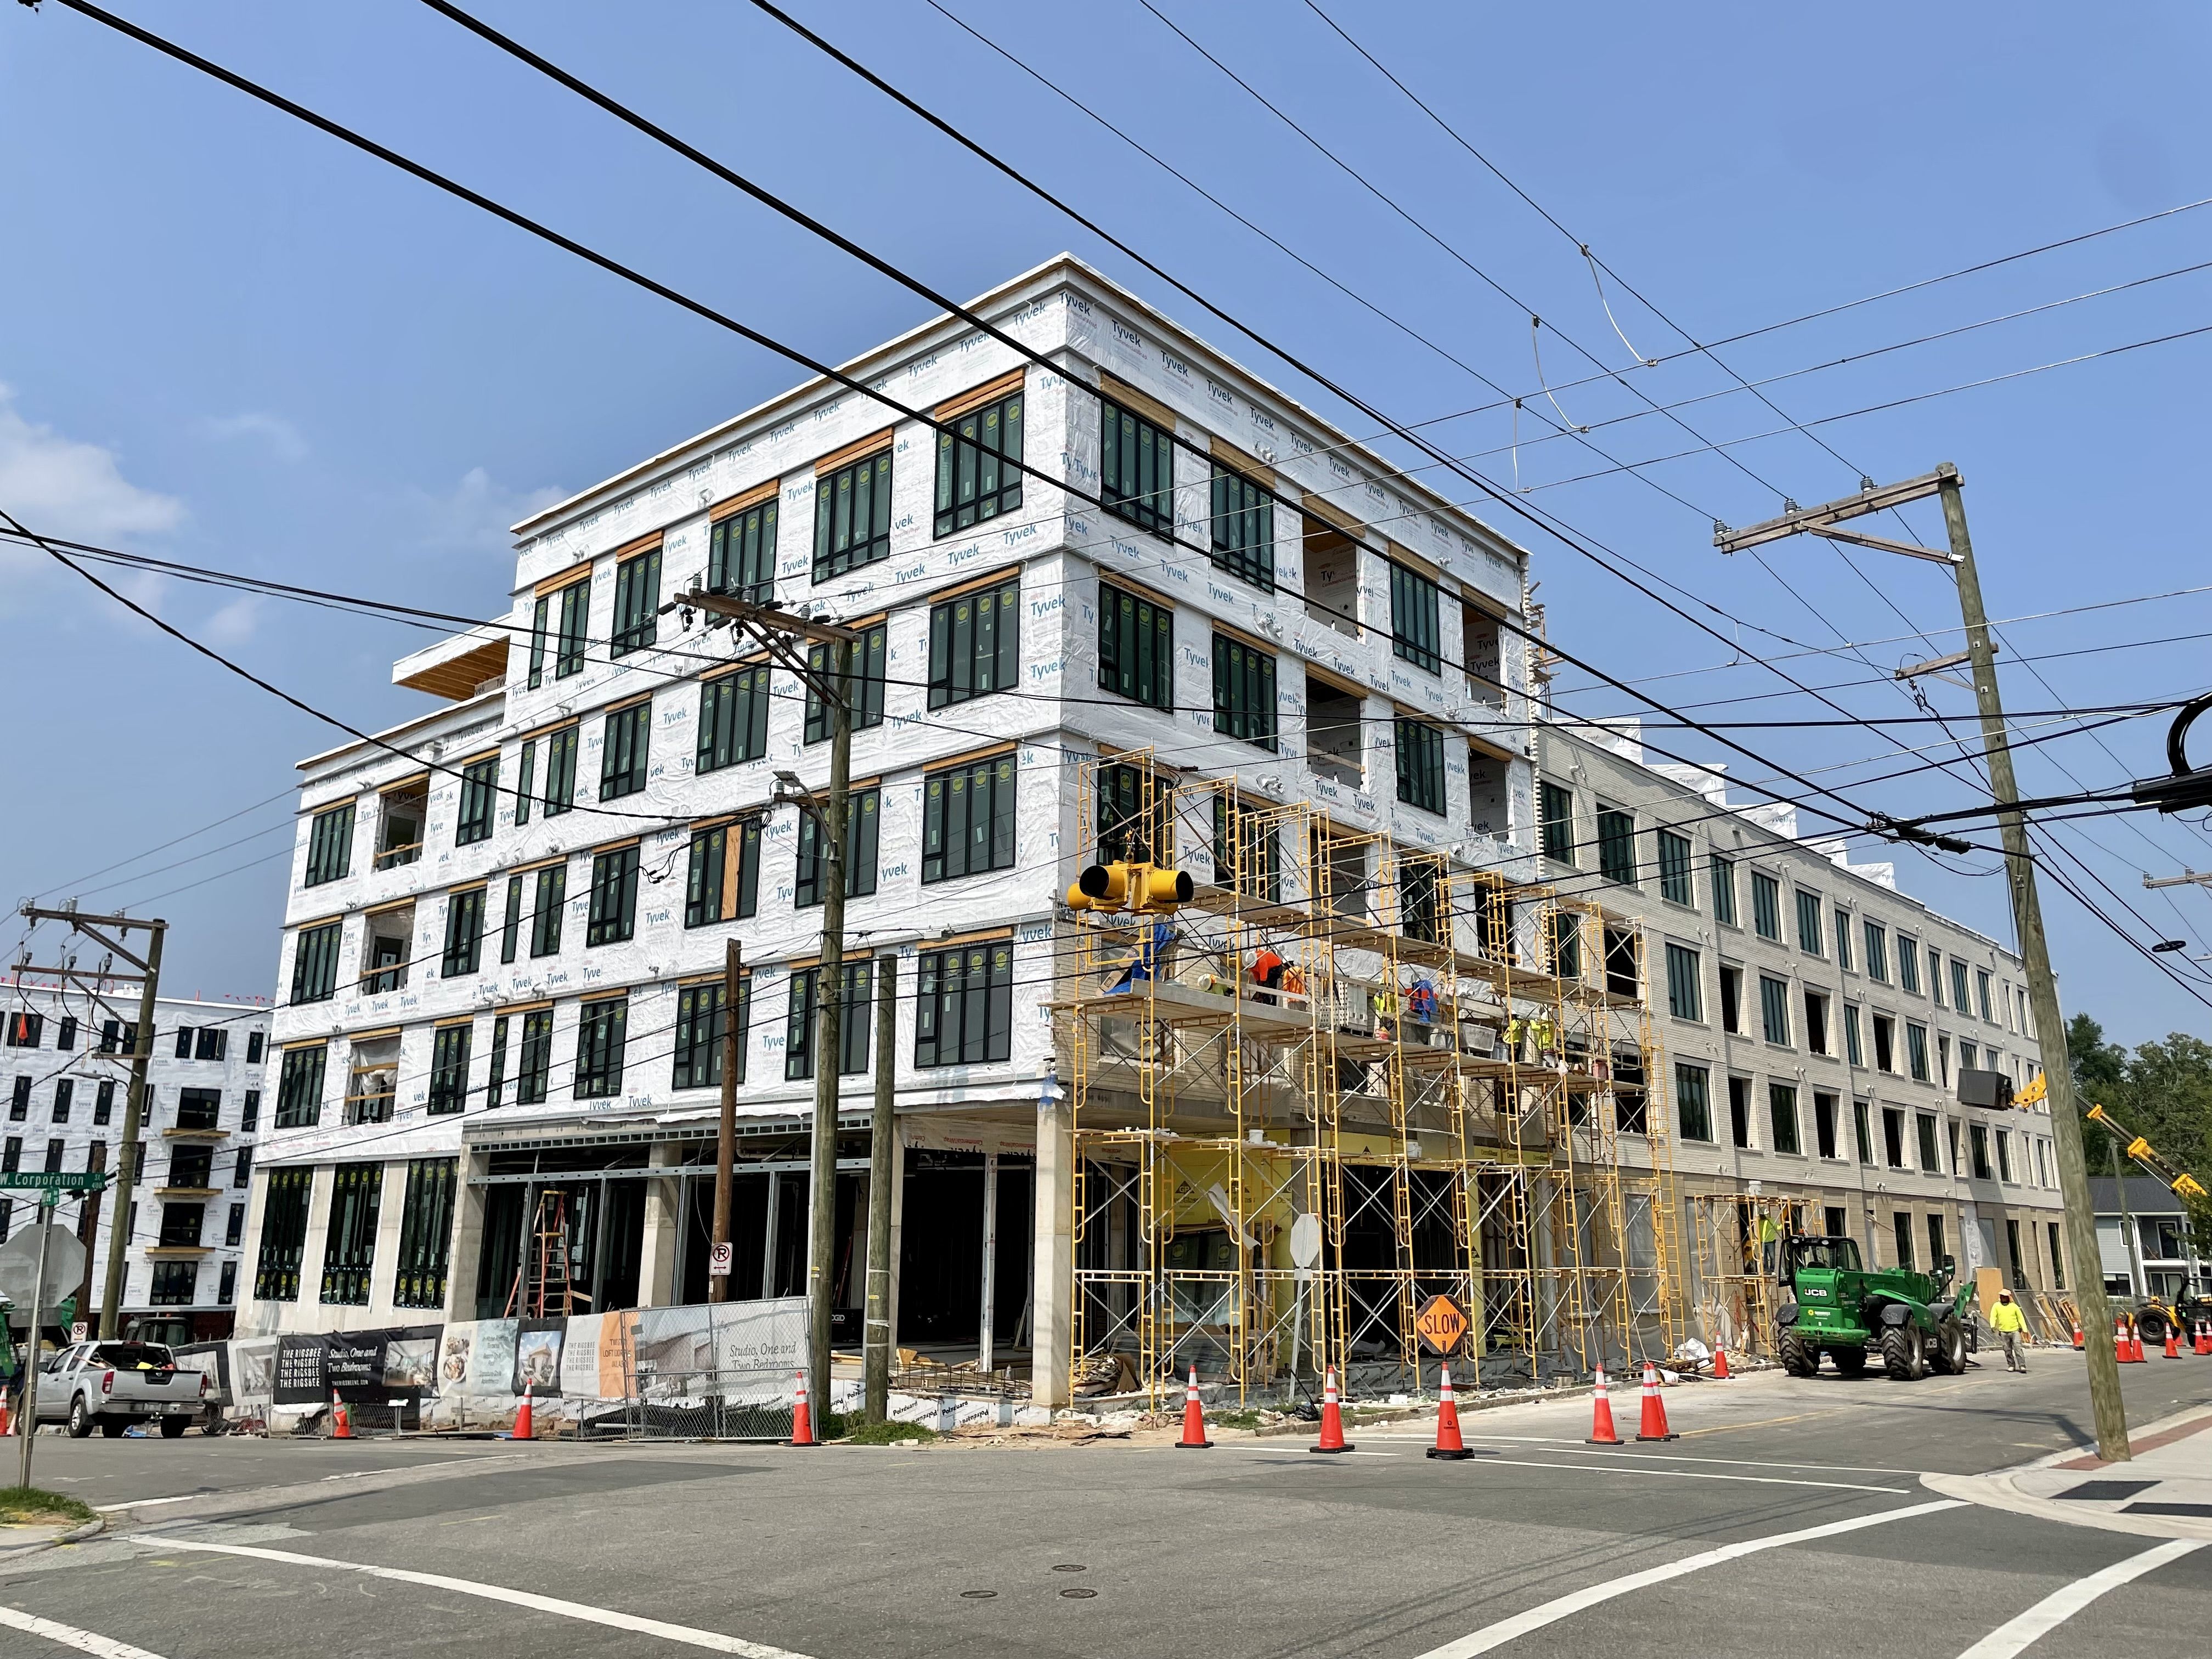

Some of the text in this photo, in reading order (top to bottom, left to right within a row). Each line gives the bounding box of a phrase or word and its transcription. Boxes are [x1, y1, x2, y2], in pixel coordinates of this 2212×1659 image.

[1059, 291, 1091, 316] Tyvek
[1014, 302, 1046, 326] Tyvek
[960, 331, 991, 352] Tyvek
[1111, 319, 1141, 347] Tyvek
[909, 354, 939, 377] Tyvek
[1161, 350, 1188, 377] Tyvek
[1207, 380, 1233, 405] Tyvek
[814, 401, 840, 421] Tyvek
[1250, 407, 1274, 431] Tyvek
[770, 422, 794, 442] Tyvek
[1290, 432, 1313, 453] Tyvek
[729, 443, 752, 461] Tyvek
[689, 462, 711, 480] Tyvek
[1328, 456, 1350, 478] Tyvek
[650, 480, 672, 497] Tyvek
[787, 481, 813, 501] Tyvek
[1364, 478, 1385, 500] Tyvek
[614, 498, 635, 515] Tyvek
[1398, 500, 1417, 520] Tyvek
[579, 514, 599, 531] Tyvek
[1176, 512, 1203, 535] Tyvek
[1430, 520, 1449, 539] Tyvek
[546, 531, 565, 547] Tyvek
[1003, 523, 1036, 546] Tyvek
[948, 544, 979, 566] Tyvek
[1110, 535, 1140, 560] Tyvek
[782, 556, 808, 575] Tyvek
[1485, 552, 1502, 569] Tyvek
[895, 563, 926, 584] Tyvek
[1160, 559, 1188, 583] Tyvek
[1207, 582, 1233, 603] Tyvek
[1031, 595, 1066, 618] Tyvek
[1294, 639, 1317, 658] Tyvek
[1030, 659, 1066, 680] Tyvek
[1334, 657, 1355, 675] Tyvek
[1391, 670, 1412, 688] Tyvek
[773, 680, 799, 700] Tyvek
[1424, 686, 1443, 703] Tyvek
[664, 708, 686, 725] Tyvek
[891, 709, 921, 730] Tyvek
[1315, 780, 1338, 798] Tyvek
[1353, 794, 1375, 811] Tyvek
[656, 828, 679, 845] Tyvek
[1415, 828, 1435, 844] Tyvek
[1183, 845, 1210, 865] Tyvek
[646, 909, 669, 926] Tyvek
[512, 975, 532, 989] Tyvek
[548, 970, 568, 986] Tyvek
[372, 999, 388, 1011] Tyvek
[400, 996, 417, 1007] Tyvek
[763, 1035, 785, 1051] Tyve
[0, 1174, 11, 1186] W.
[15, 1173, 84, 1187] Corporation
[1425, 1313, 1460, 1334] SLOW
[350, 1347, 364, 1358] One
[364, 1346, 378, 1357] and
[761, 1343, 779, 1355] One
[780, 1341, 796, 1353] and
[1925, 1338, 1937, 1348] JCB
[283, 1347, 321, 1358] THE RIGSBEE
[281, 1357, 319, 1368] THE RIGSBEE
[327, 1362, 372, 1373] Two Bedrooms
[732, 1359, 794, 1369] Two Bedrooms
[280, 1368, 319, 1378] THE RIGSBEE
[280, 1378, 320, 1388] THE RIGSBEE
